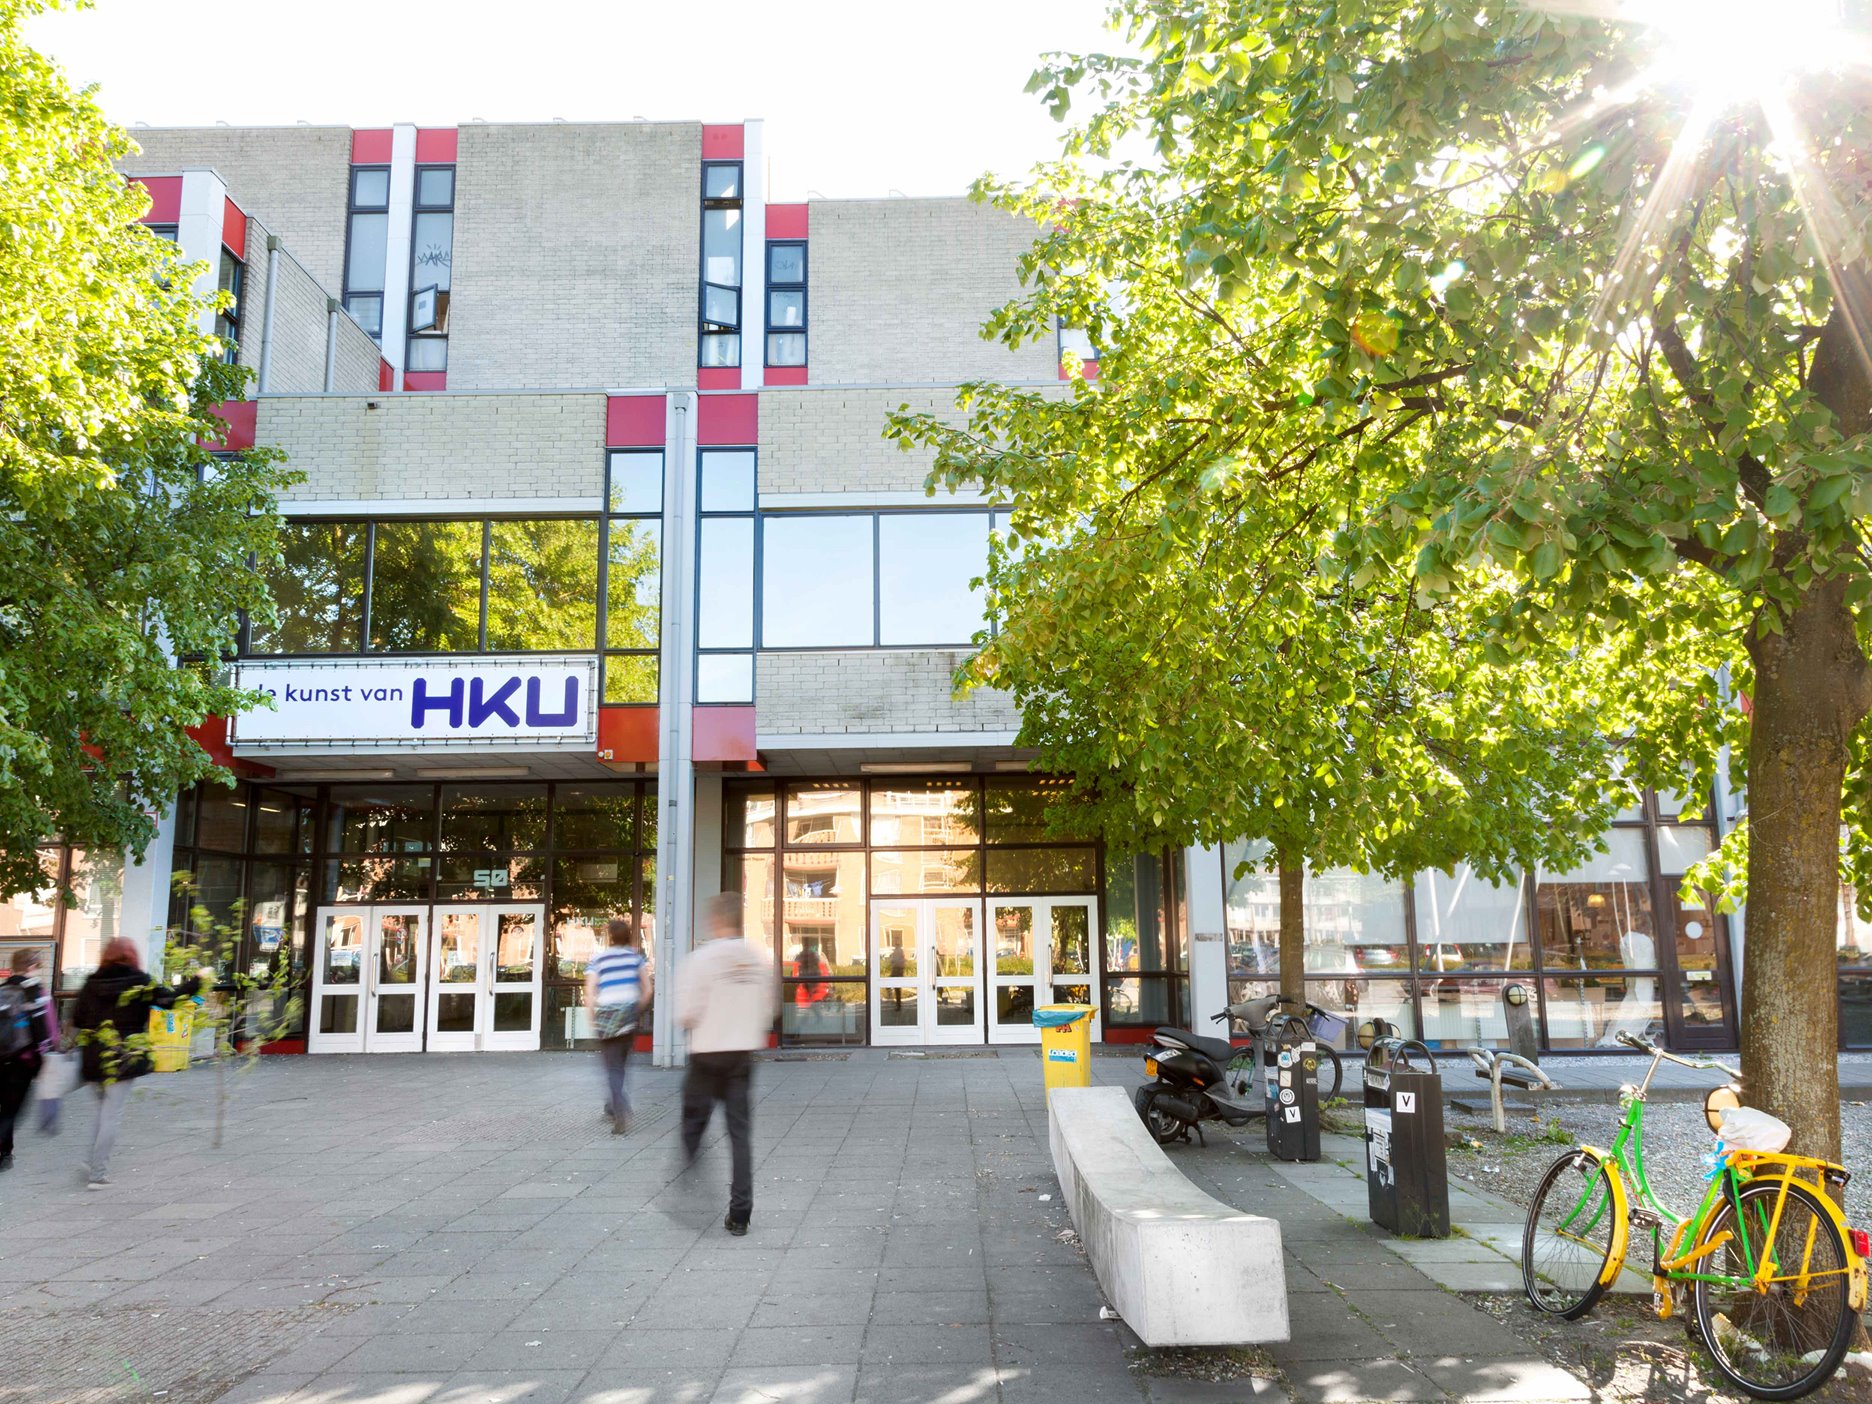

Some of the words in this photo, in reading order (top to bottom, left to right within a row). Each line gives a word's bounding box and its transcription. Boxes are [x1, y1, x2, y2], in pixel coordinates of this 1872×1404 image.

[285, 683, 353, 702] kunst
[360, 688, 404, 701] van
[411, 675, 579, 729] HKU
[1402, 1095, 1411, 1108] V
[1289, 1108, 1296, 1119] V
